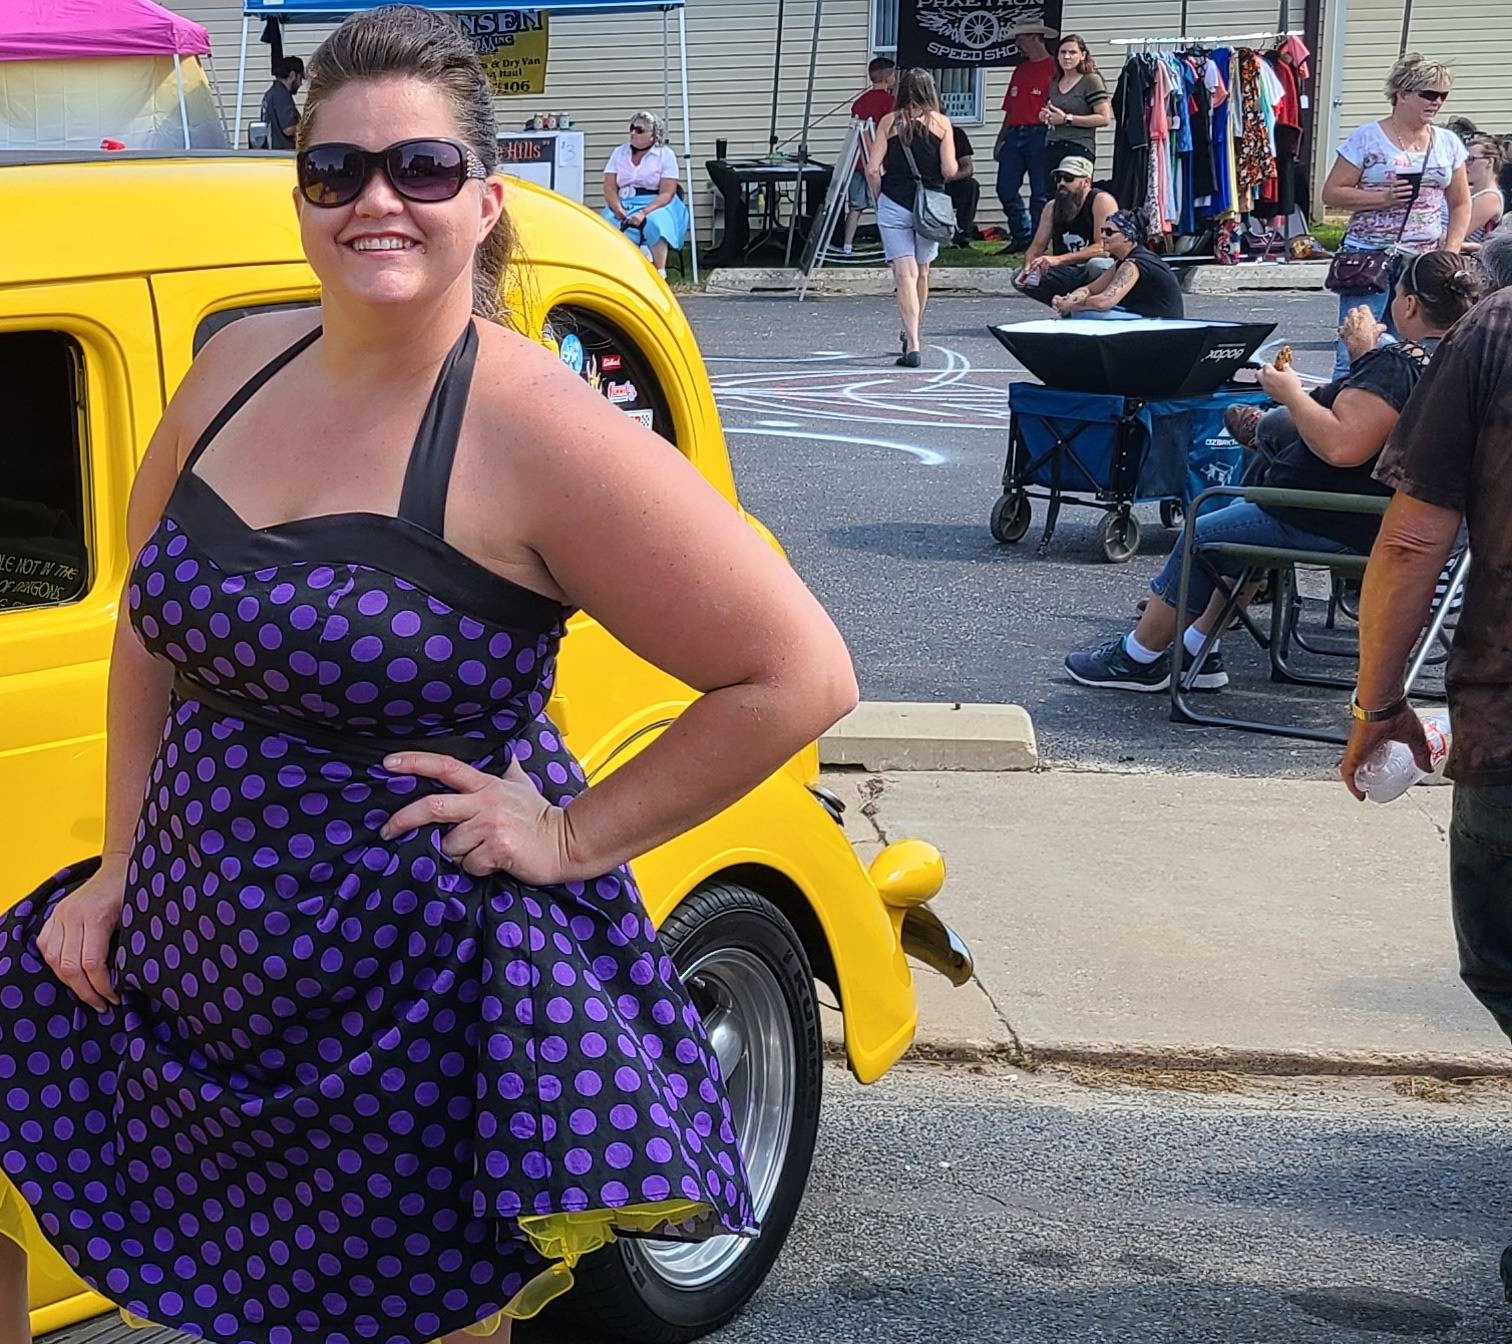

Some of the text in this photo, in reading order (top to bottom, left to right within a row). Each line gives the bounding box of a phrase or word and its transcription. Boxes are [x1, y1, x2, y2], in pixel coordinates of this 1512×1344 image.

[927, 41, 1021, 61] SPEED SHO
[16, 558, 42, 575] NOT
